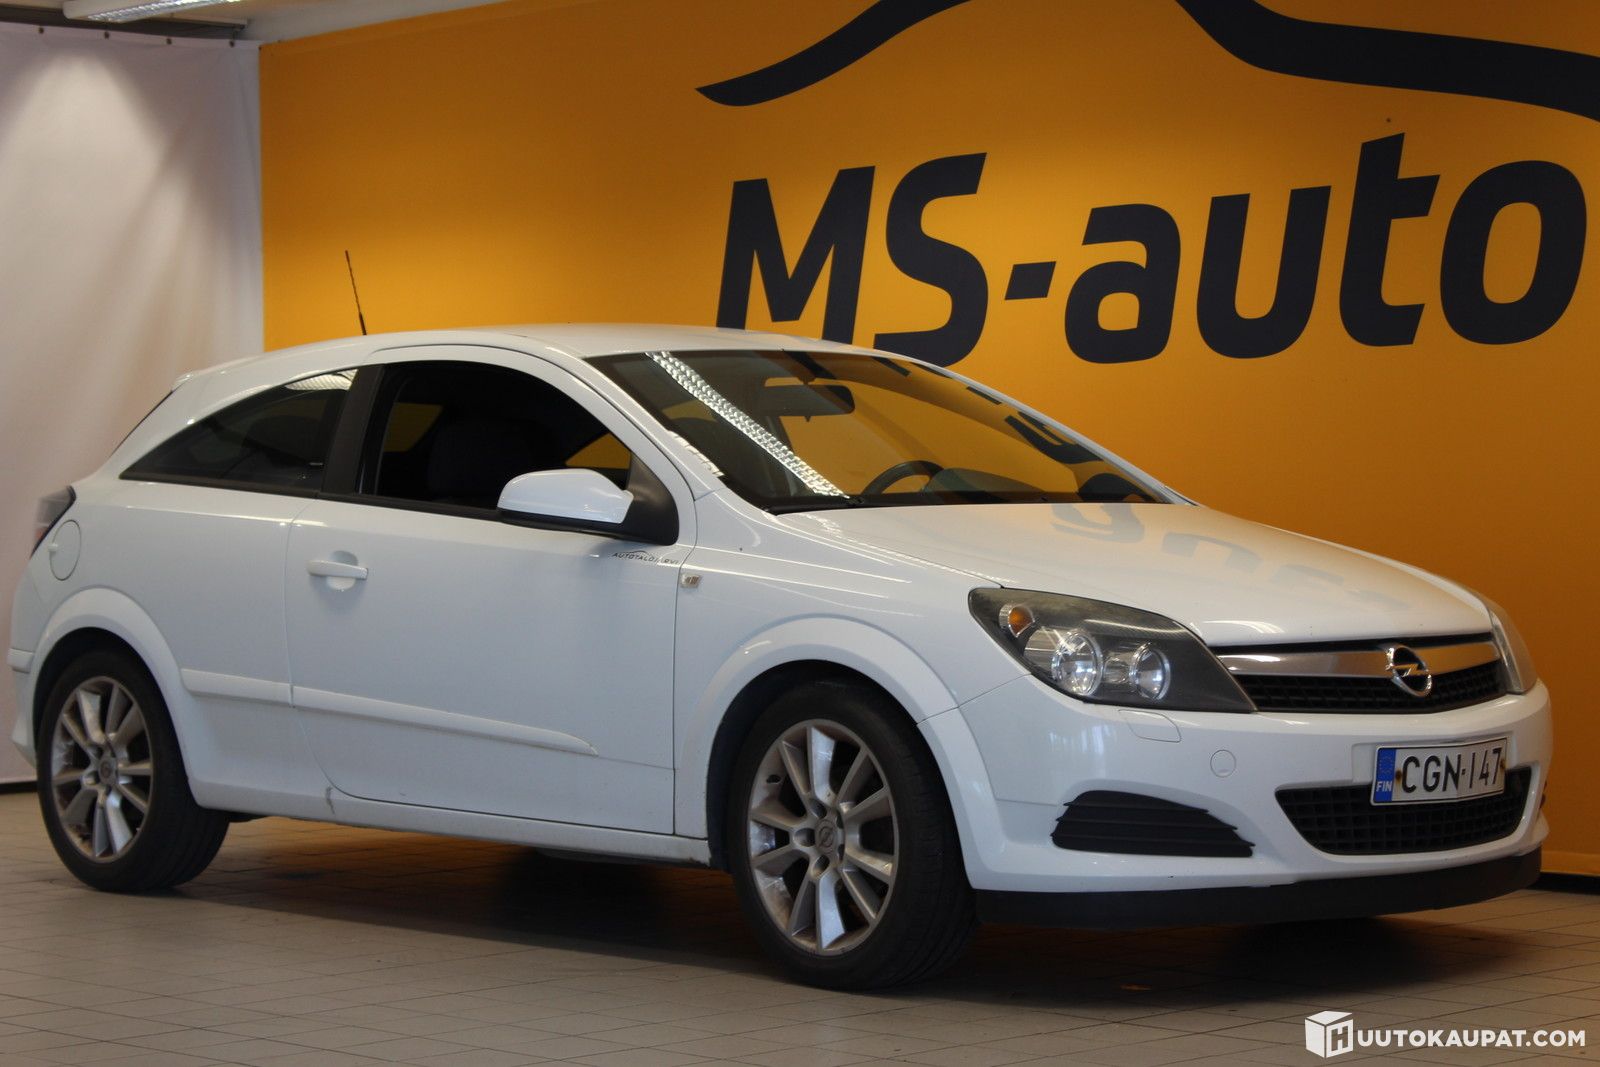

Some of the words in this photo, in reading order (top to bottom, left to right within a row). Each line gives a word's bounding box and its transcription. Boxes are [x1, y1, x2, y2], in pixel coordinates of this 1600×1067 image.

[716, 132, 1588, 368] MS-auto
[1376, 780, 1393, 793] FIN
[1402, 746, 1503, 794] CGN-147
